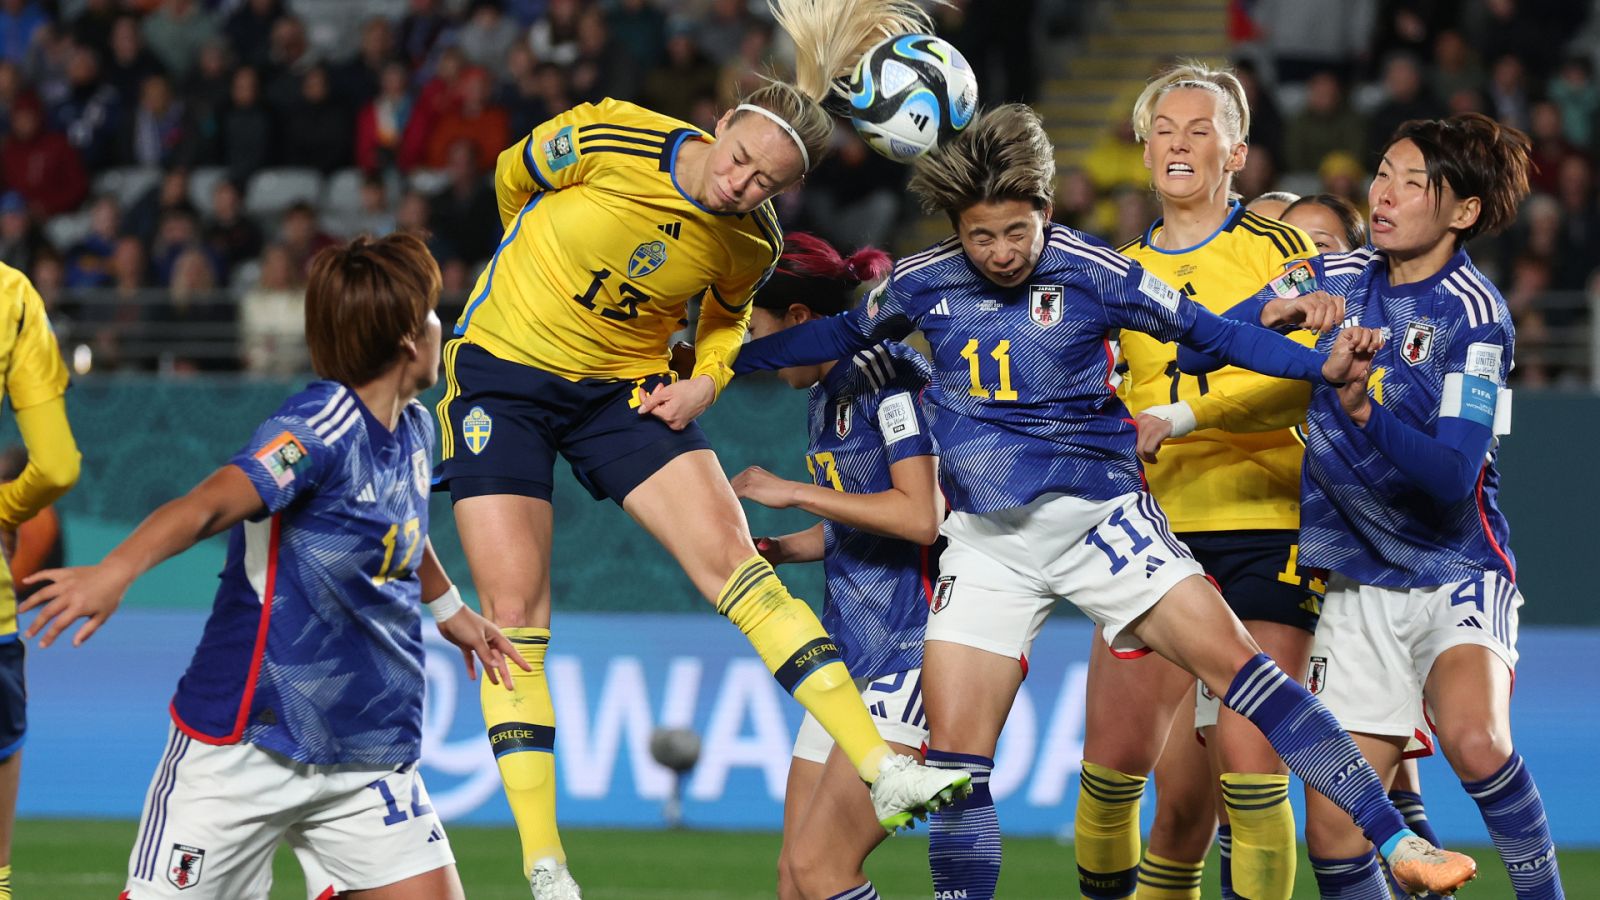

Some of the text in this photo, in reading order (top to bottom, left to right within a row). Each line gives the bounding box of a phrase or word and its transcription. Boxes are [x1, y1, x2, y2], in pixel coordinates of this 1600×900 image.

[573, 268, 651, 321] 13
[1038, 314, 1053, 322] JFA
[960, 338, 1018, 400] 11
[1471, 387, 1491, 400] FIFA
[1085, 506, 1154, 576] 11
[1450, 572, 1485, 613] 4
[490, 729, 534, 746] ERIGE
[934, 889, 968, 900] PAN
